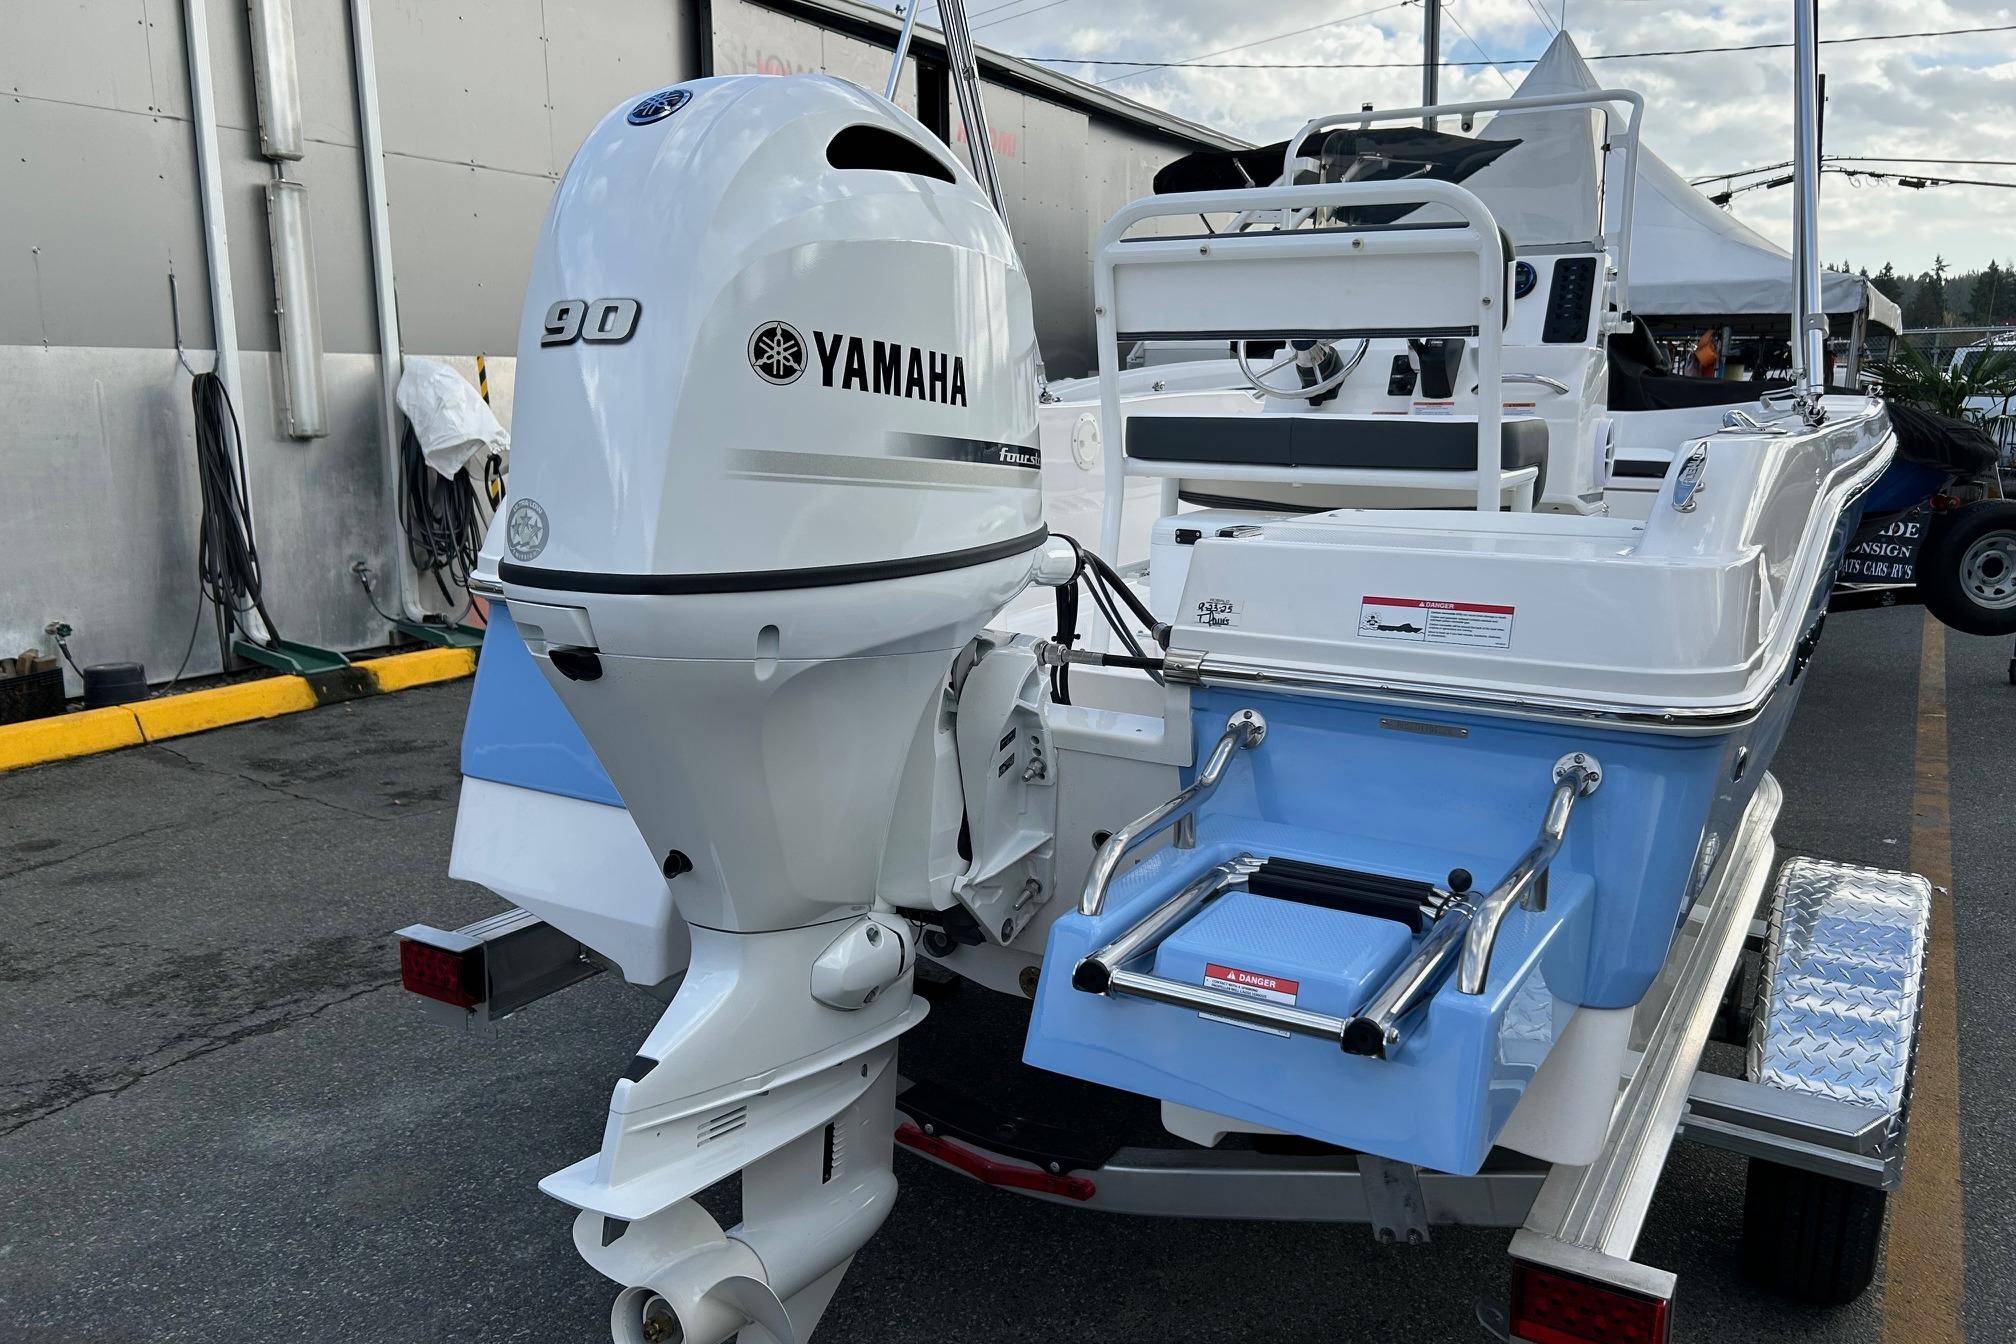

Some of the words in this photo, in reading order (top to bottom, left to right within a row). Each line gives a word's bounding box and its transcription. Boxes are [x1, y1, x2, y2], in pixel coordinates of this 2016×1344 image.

[541, 298, 641, 348] 90
[813, 330, 968, 407] YAMAHA
[530, 500, 543, 514] LOW
[1863, 560, 1888, 577] CARS
[1890, 563, 1913, 580] RV'S
[1239, 973, 1276, 988] DANGER
